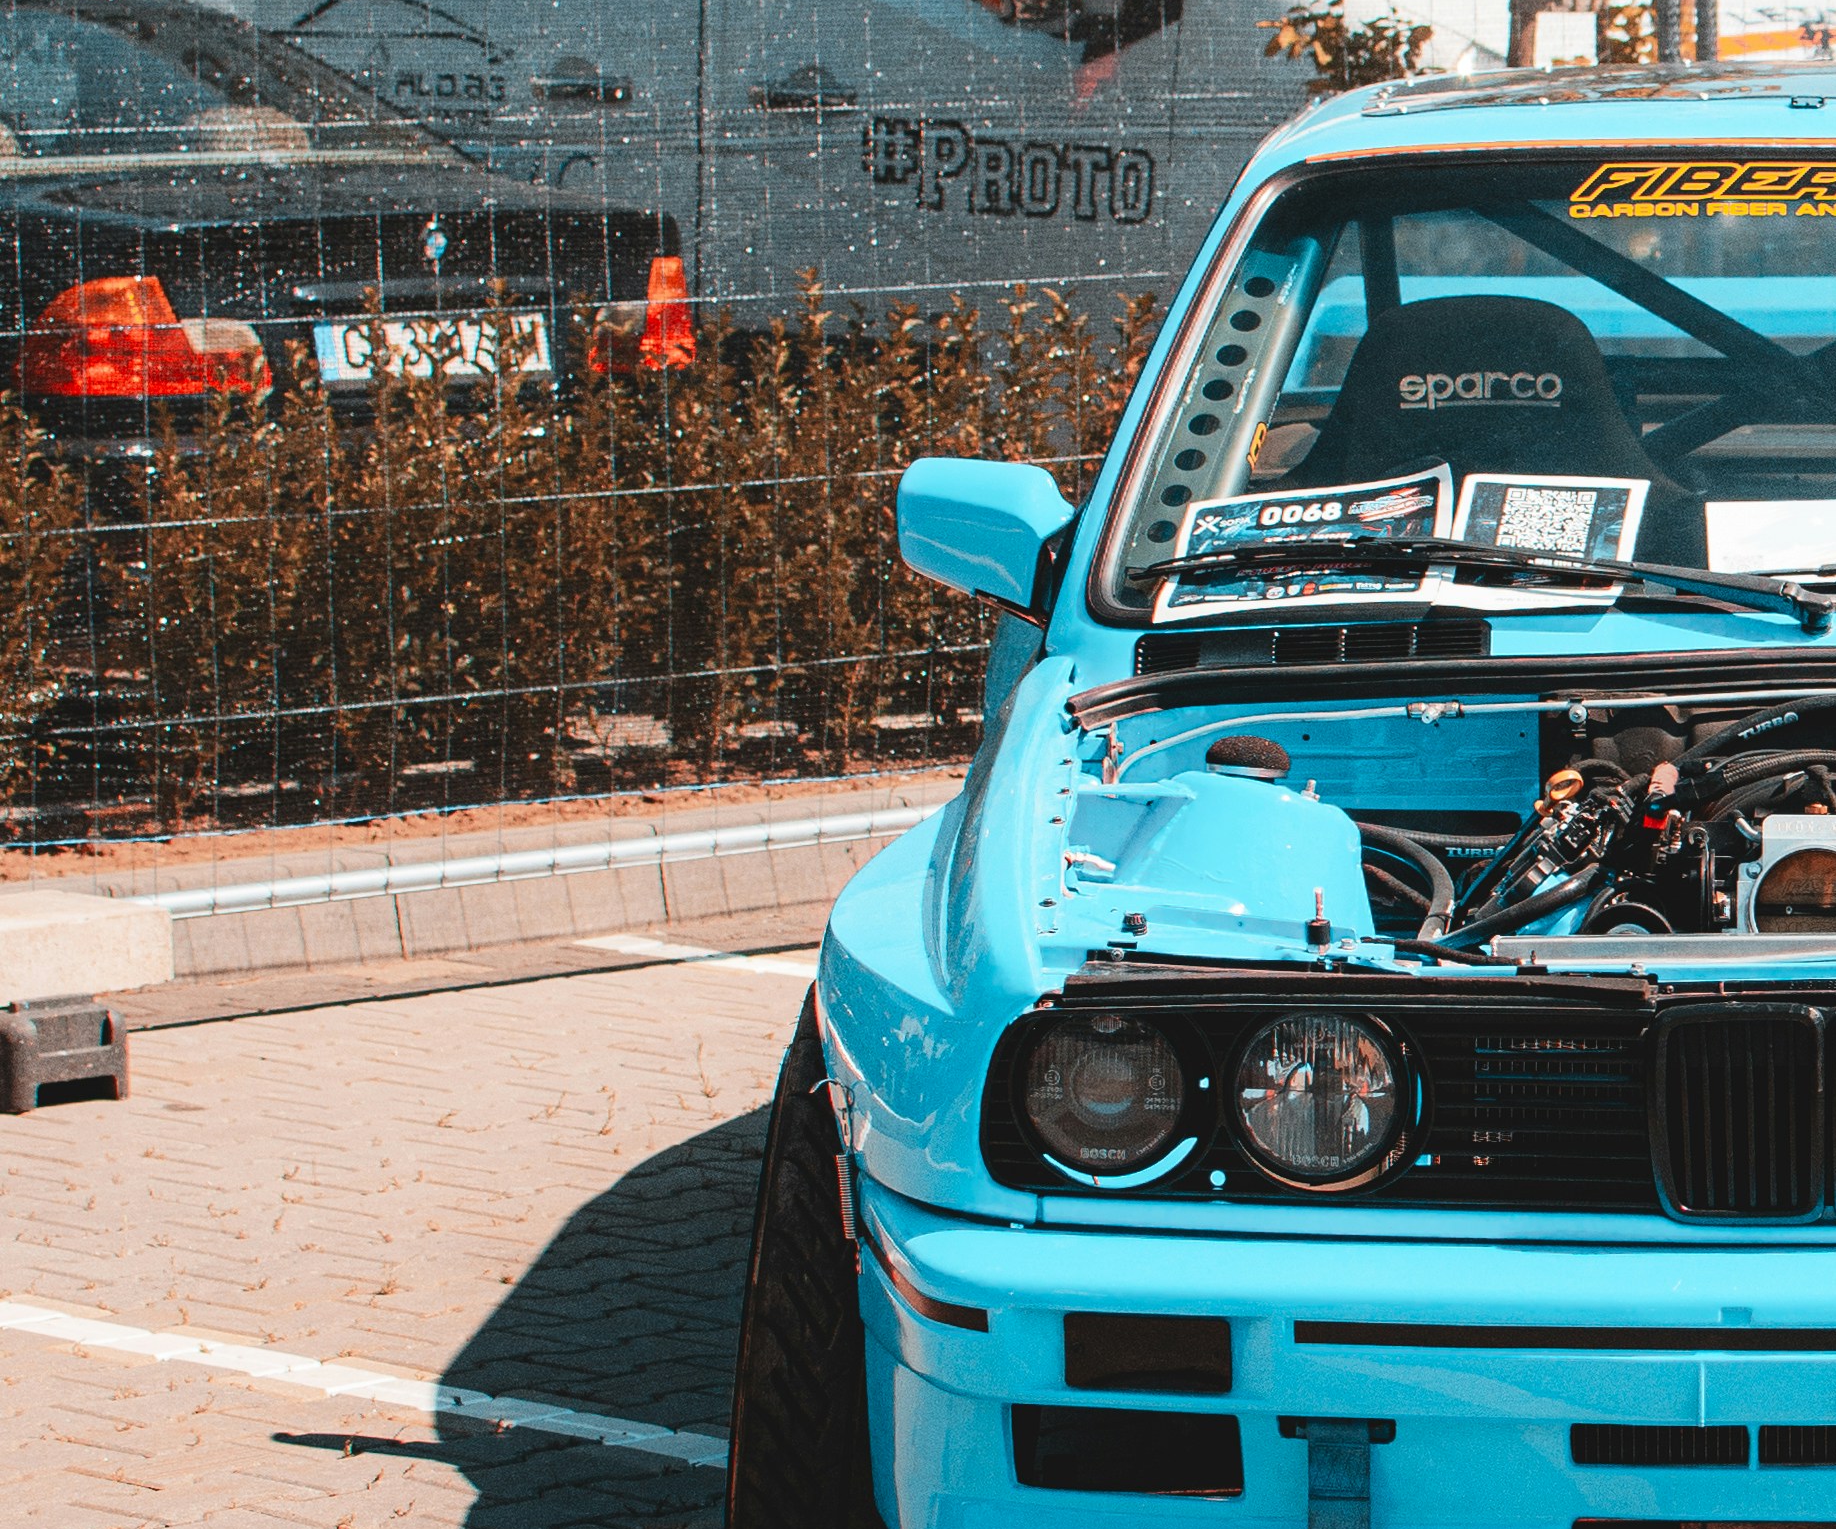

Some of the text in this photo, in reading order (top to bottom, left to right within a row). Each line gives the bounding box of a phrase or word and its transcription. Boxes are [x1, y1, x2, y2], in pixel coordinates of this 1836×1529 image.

[1569, 201, 1700, 219] CARBON
[1706, 202, 1792, 218] FIBER
[1399, 371, 1563, 410] sparco
[1259, 501, 1343, 526] 0068
